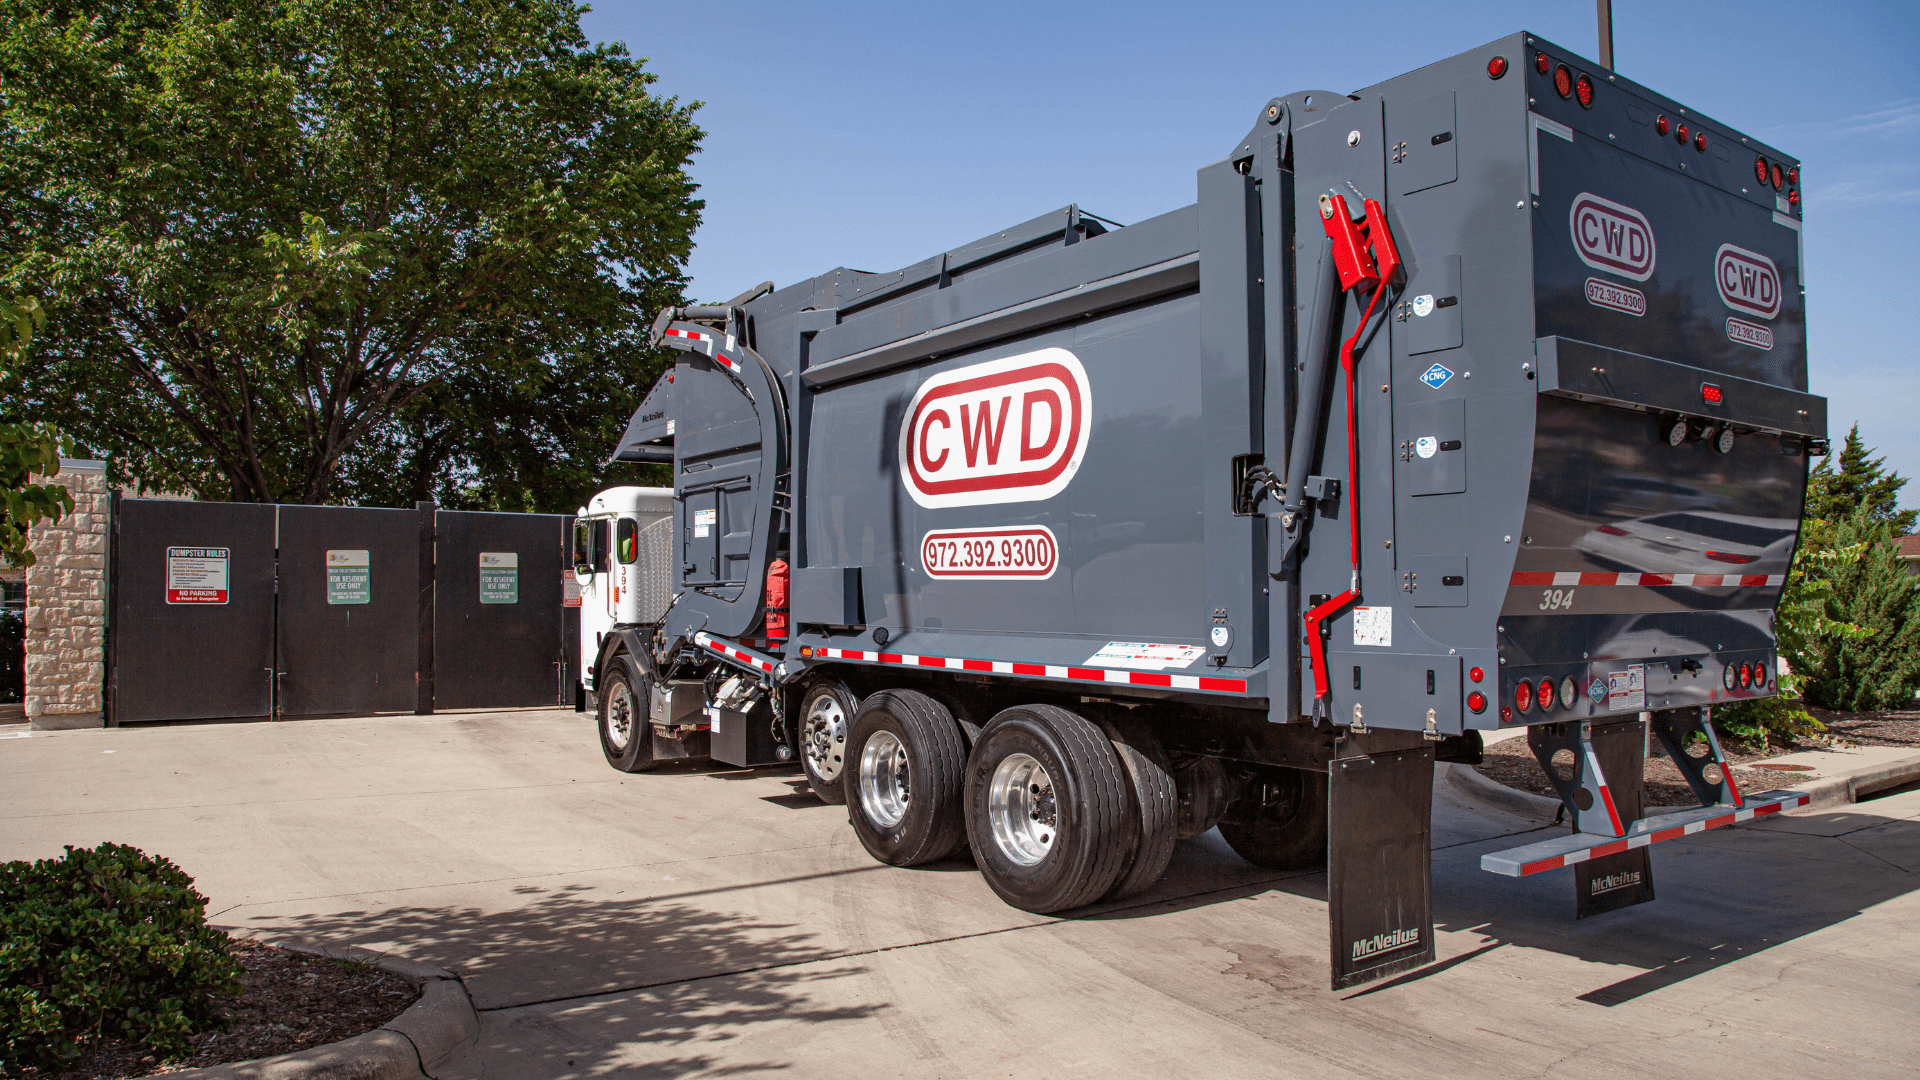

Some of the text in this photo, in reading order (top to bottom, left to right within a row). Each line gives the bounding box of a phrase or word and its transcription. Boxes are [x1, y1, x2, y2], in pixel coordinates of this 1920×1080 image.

[1581, 212, 1645, 263] CWD
[1723, 261, 1773, 303] CWD
[1588, 284, 1643, 310] 972.392.9300
[1729, 323, 1770, 345] 972.392.9300
[1429, 371, 1446, 381] CNG
[919, 388, 1062, 473] CWD
[171, 549, 205, 557] DUMPSTER
[928, 538, 1048, 567] 972.392.9300
[1539, 589, 1575, 610] 394
[1591, 871, 1640, 892] McNeilus
[1352, 927, 1418, 958] McNeilus
